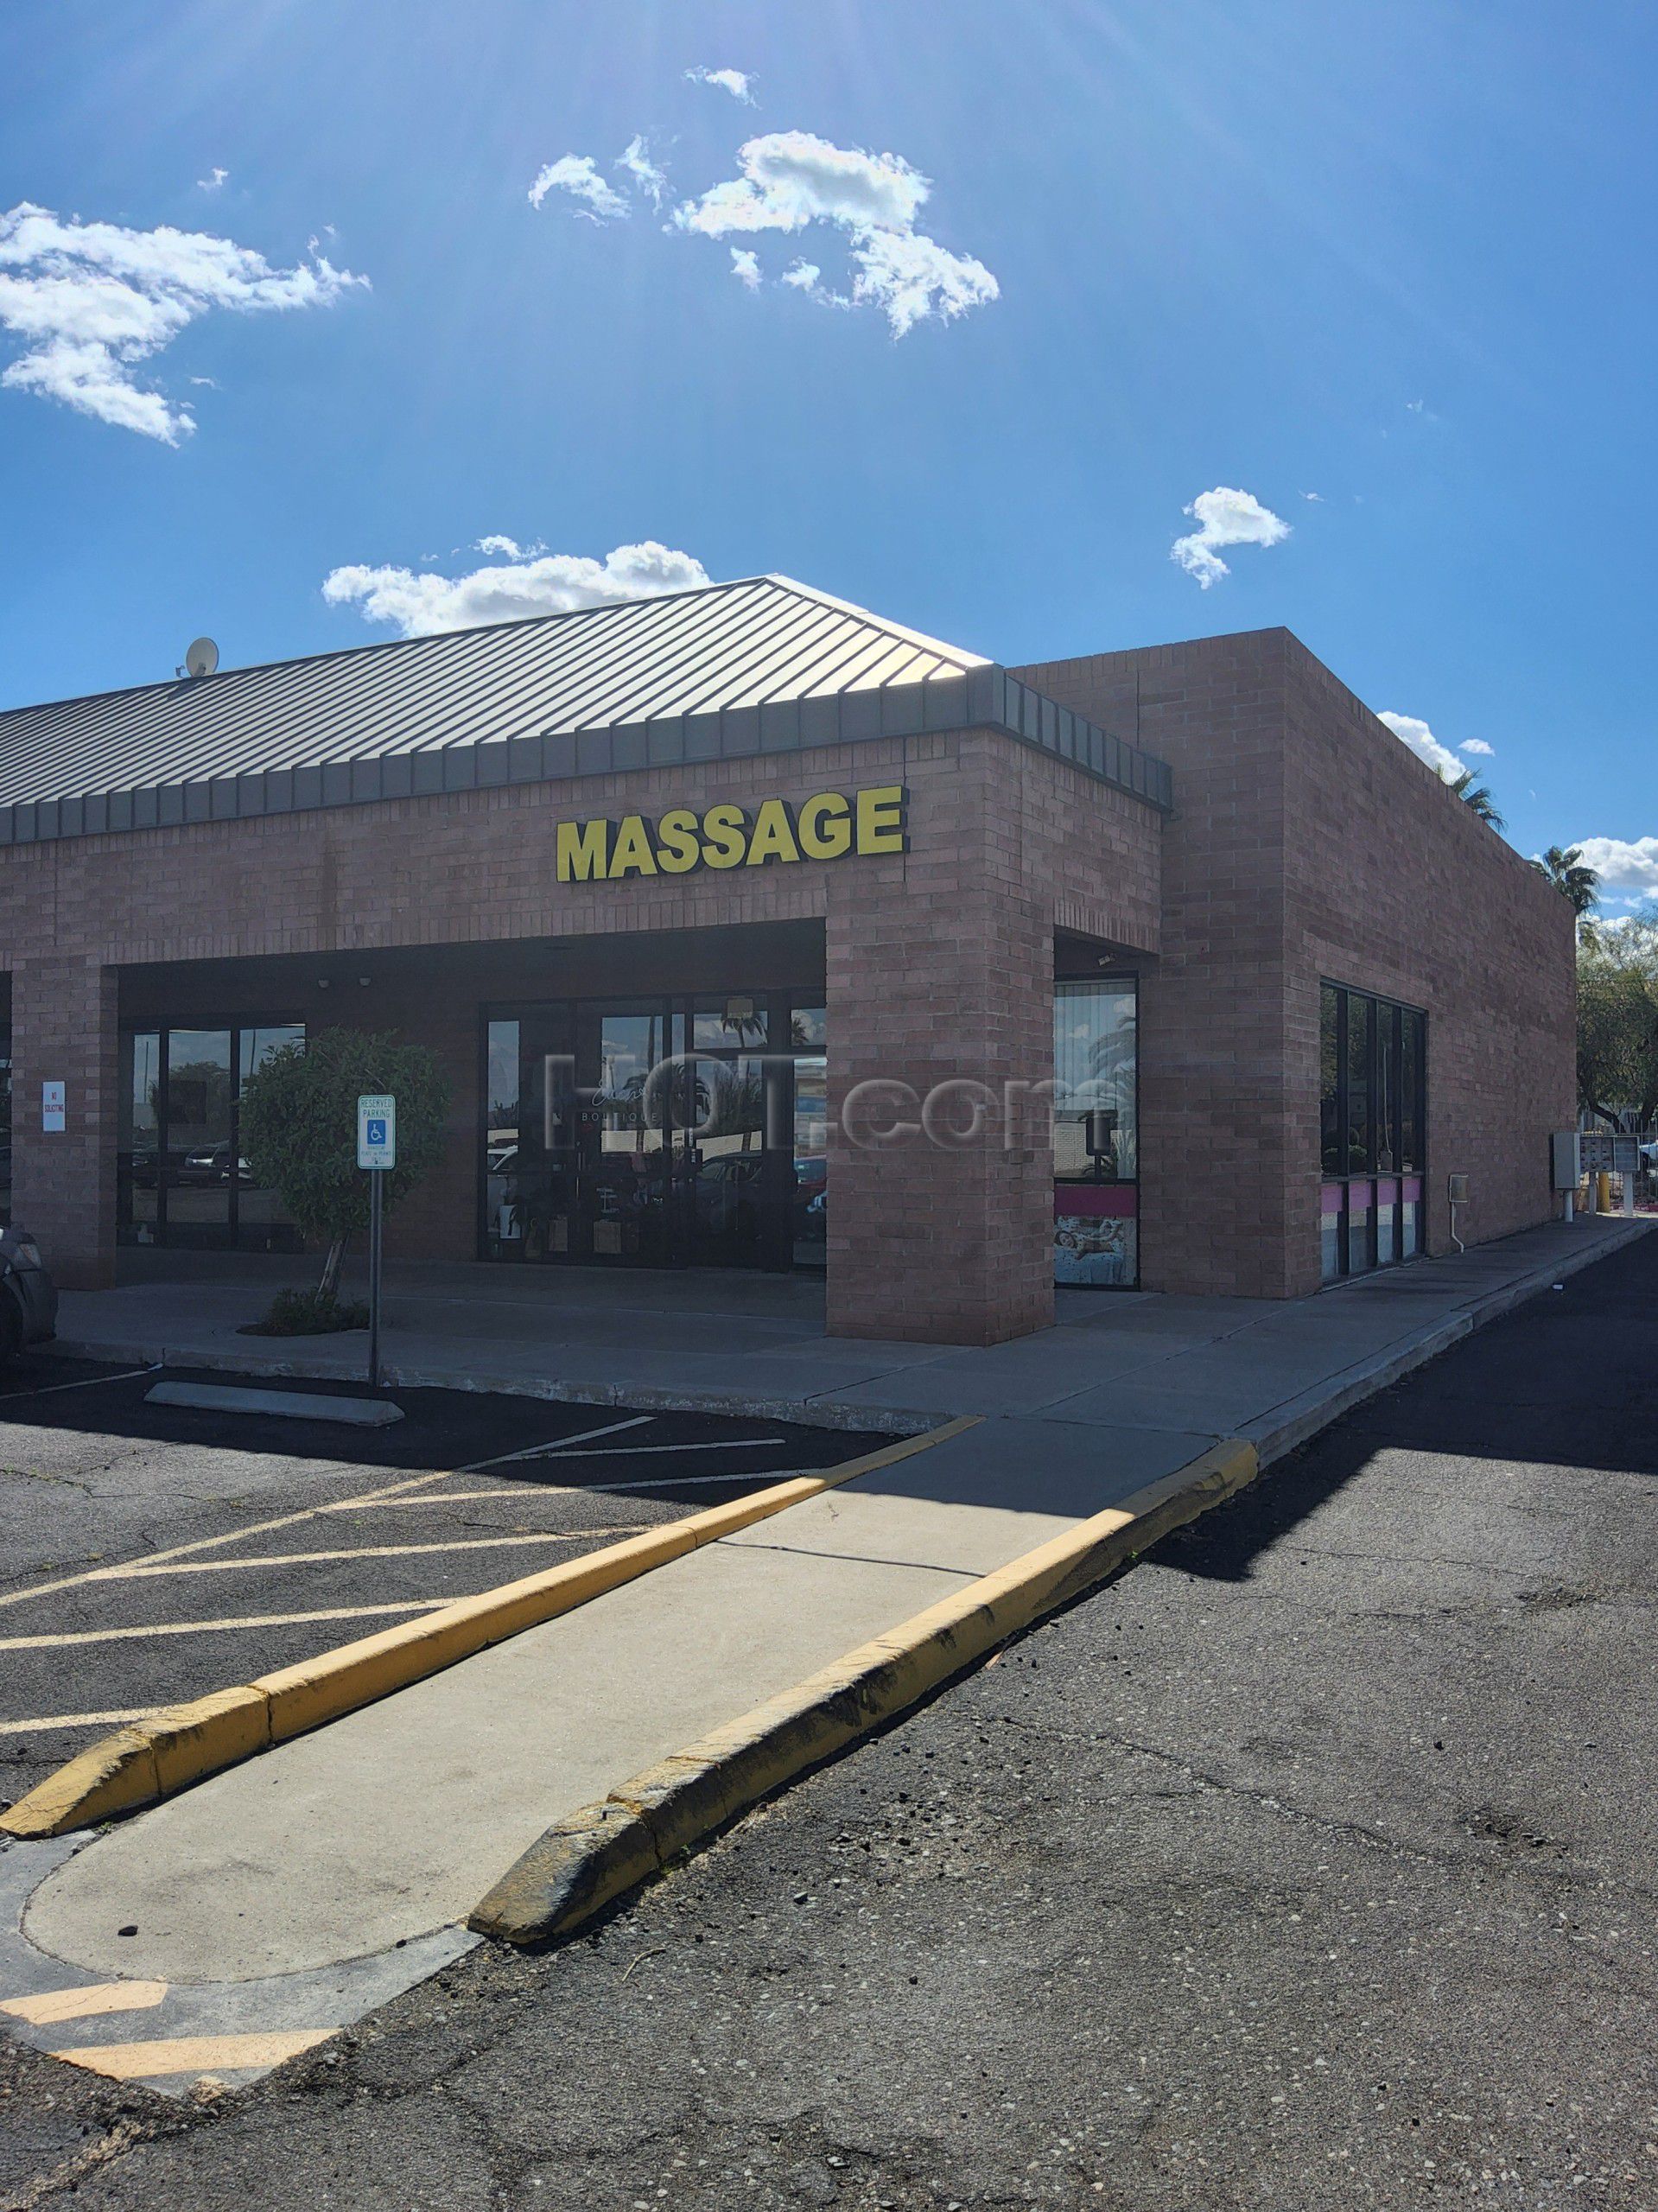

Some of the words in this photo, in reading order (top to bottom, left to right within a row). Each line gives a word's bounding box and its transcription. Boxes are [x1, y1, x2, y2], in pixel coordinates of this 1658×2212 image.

[556, 785, 905, 882] MASSAGE
[361, 1098, 392, 1109] RESERVED
[363, 1109, 391, 1118] PARKING
[581, 1112, 657, 1122] BOUTIQUE
